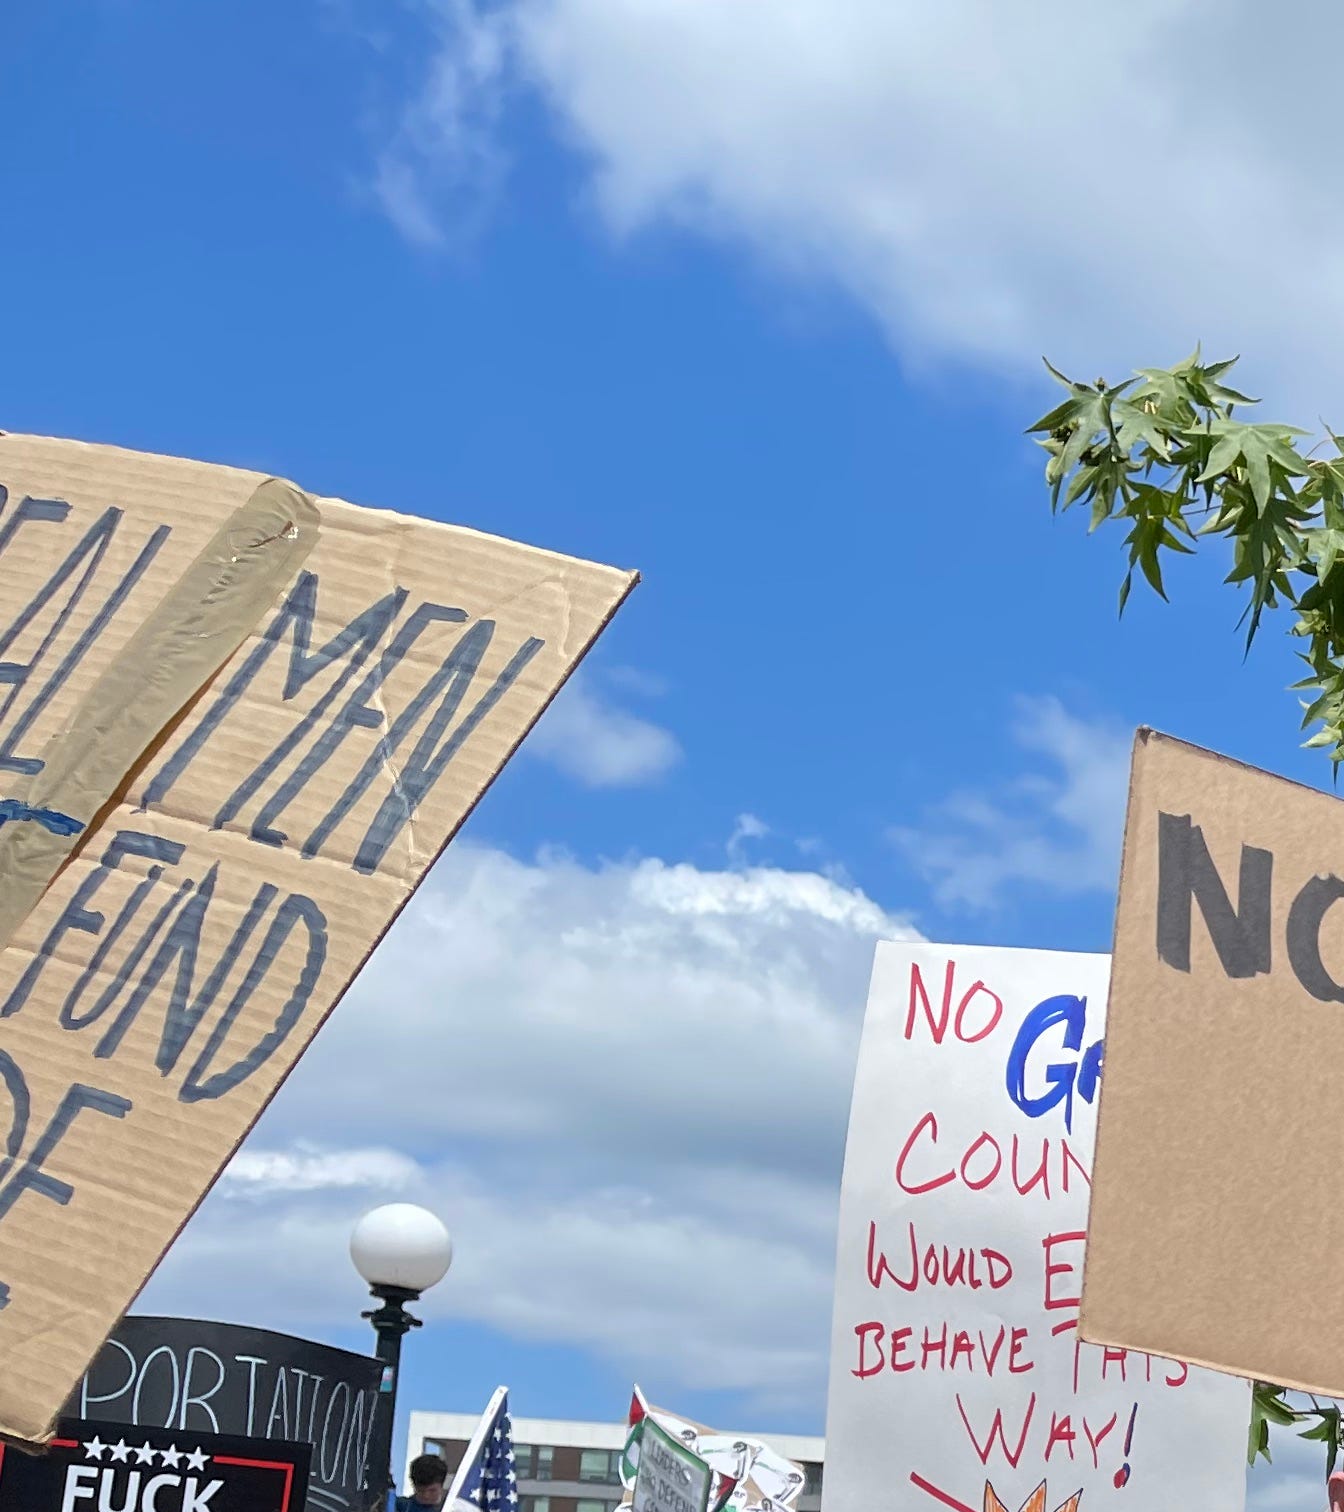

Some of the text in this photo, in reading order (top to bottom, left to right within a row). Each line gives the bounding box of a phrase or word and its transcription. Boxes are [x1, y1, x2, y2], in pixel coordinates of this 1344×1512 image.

[131, 568, 546, 874] MEN
[0, 830, 328, 1102] FUND
[903, 958, 1003, 1044] NO
[865, 1220, 1013, 1293] WOULD
[851, 1320, 1035, 1381] BEHAVE
[956, 1393, 1138, 1489] WAY!
